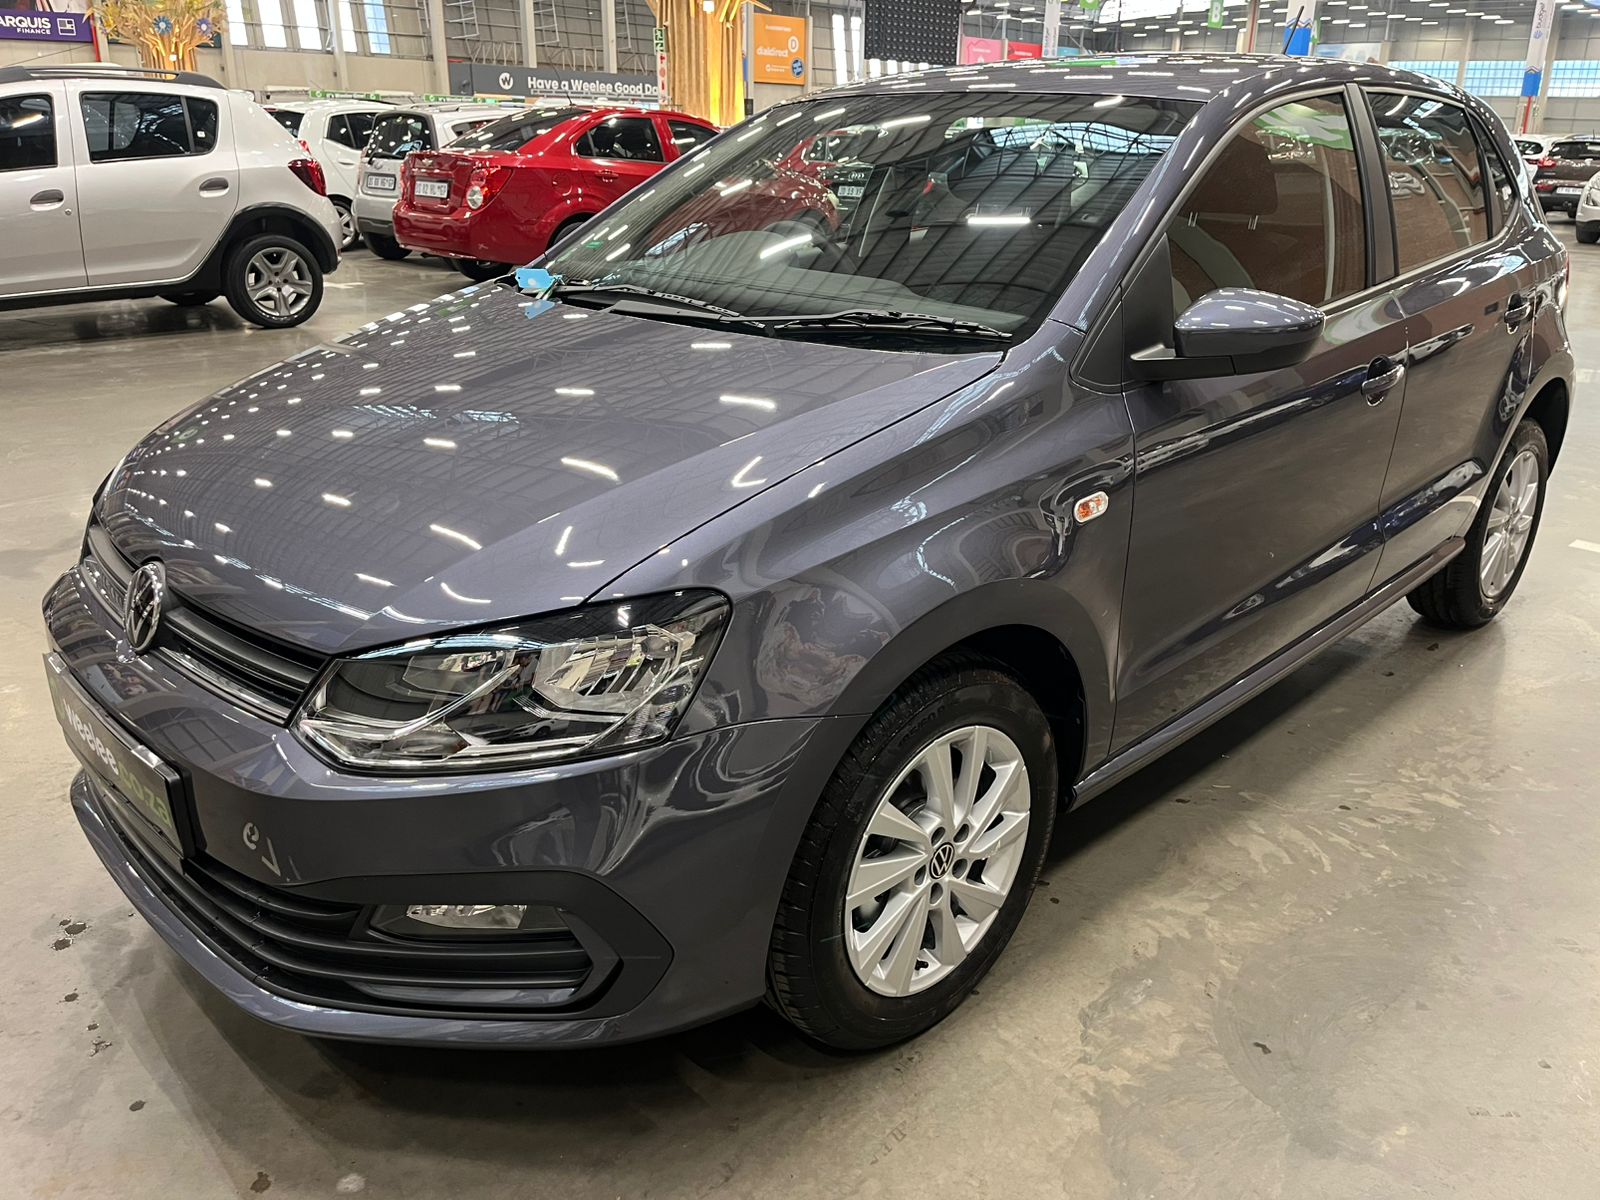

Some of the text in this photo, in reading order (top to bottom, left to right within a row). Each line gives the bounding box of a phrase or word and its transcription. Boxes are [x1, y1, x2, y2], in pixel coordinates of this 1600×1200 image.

[528, 77, 559, 91] Have
[560, 80, 570, 91] a
[570, 79, 612, 93] Weelee
[614, 82, 643, 94] Good
